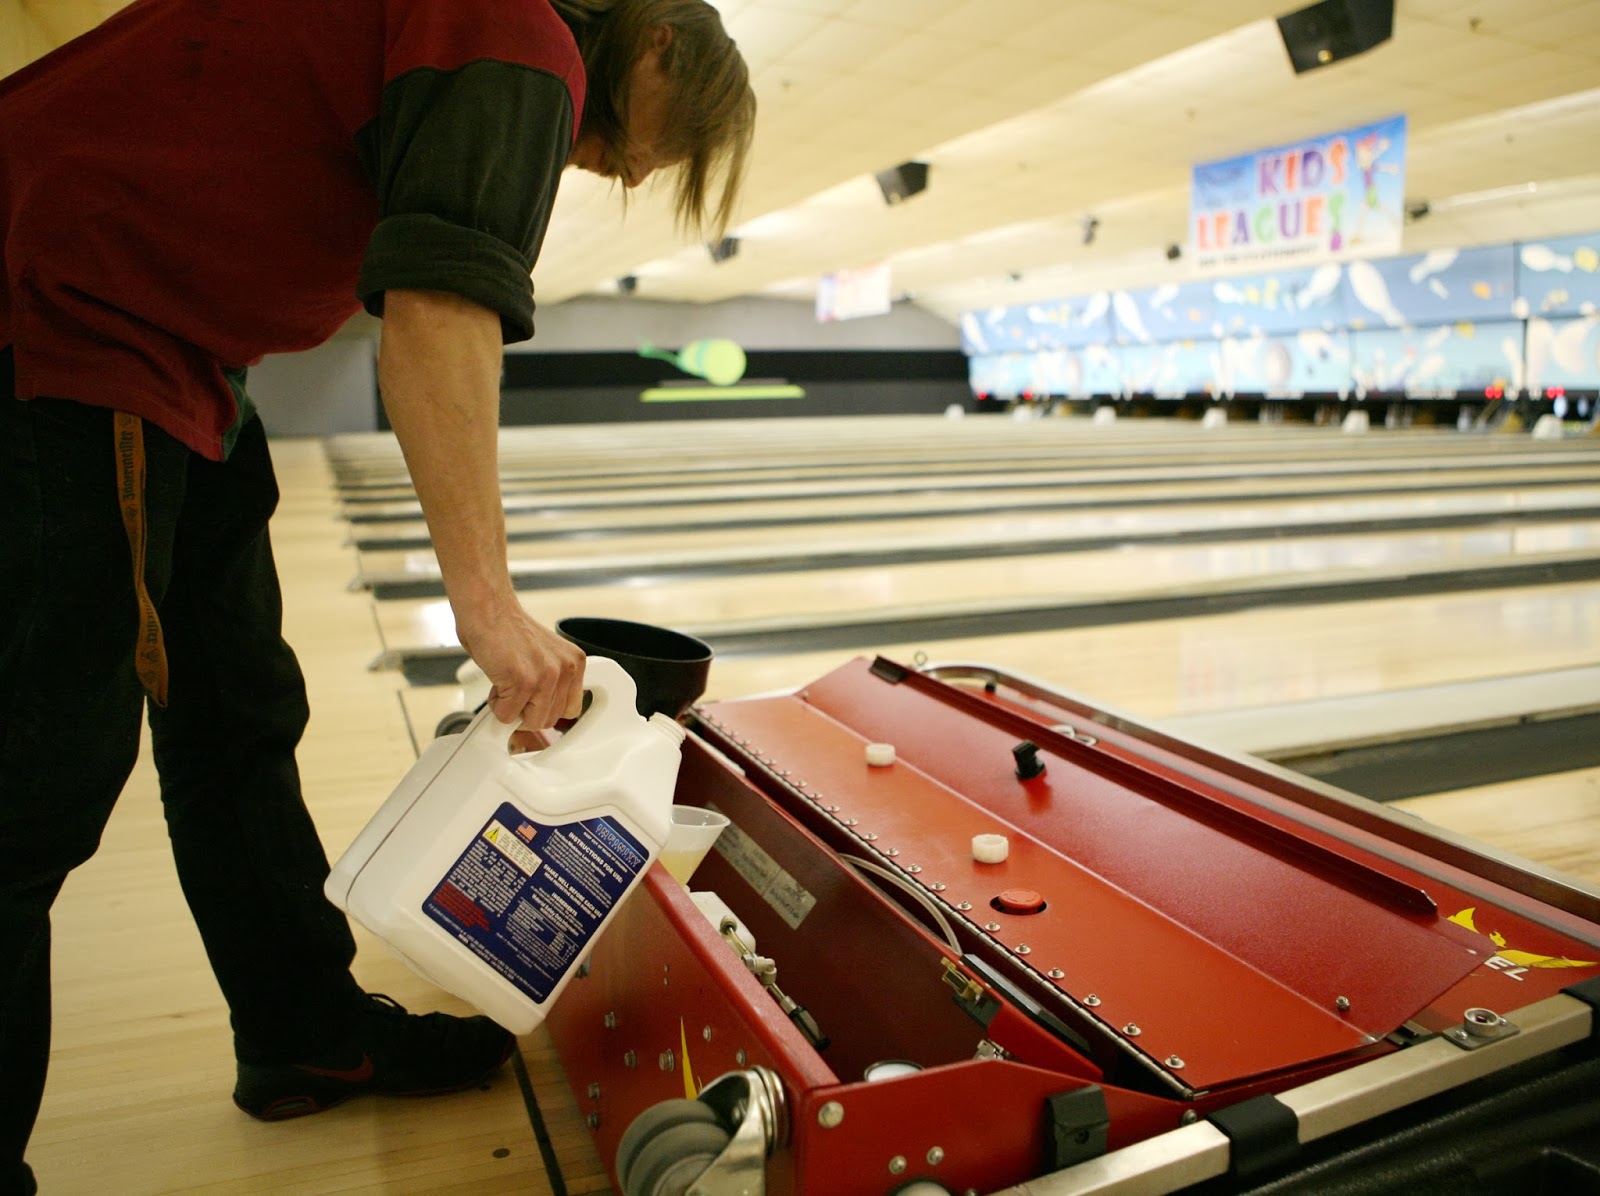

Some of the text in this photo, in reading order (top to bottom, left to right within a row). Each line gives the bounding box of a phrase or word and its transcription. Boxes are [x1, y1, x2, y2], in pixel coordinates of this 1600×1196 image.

[1259, 139, 1346, 196] KIDS
[568, 832, 623, 883] INSTRUCTIONS FOR USE:
[596, 823, 640, 865] INFINITY
[543, 864, 602, 917] SHAKE WELL BEFORE EACH USE
